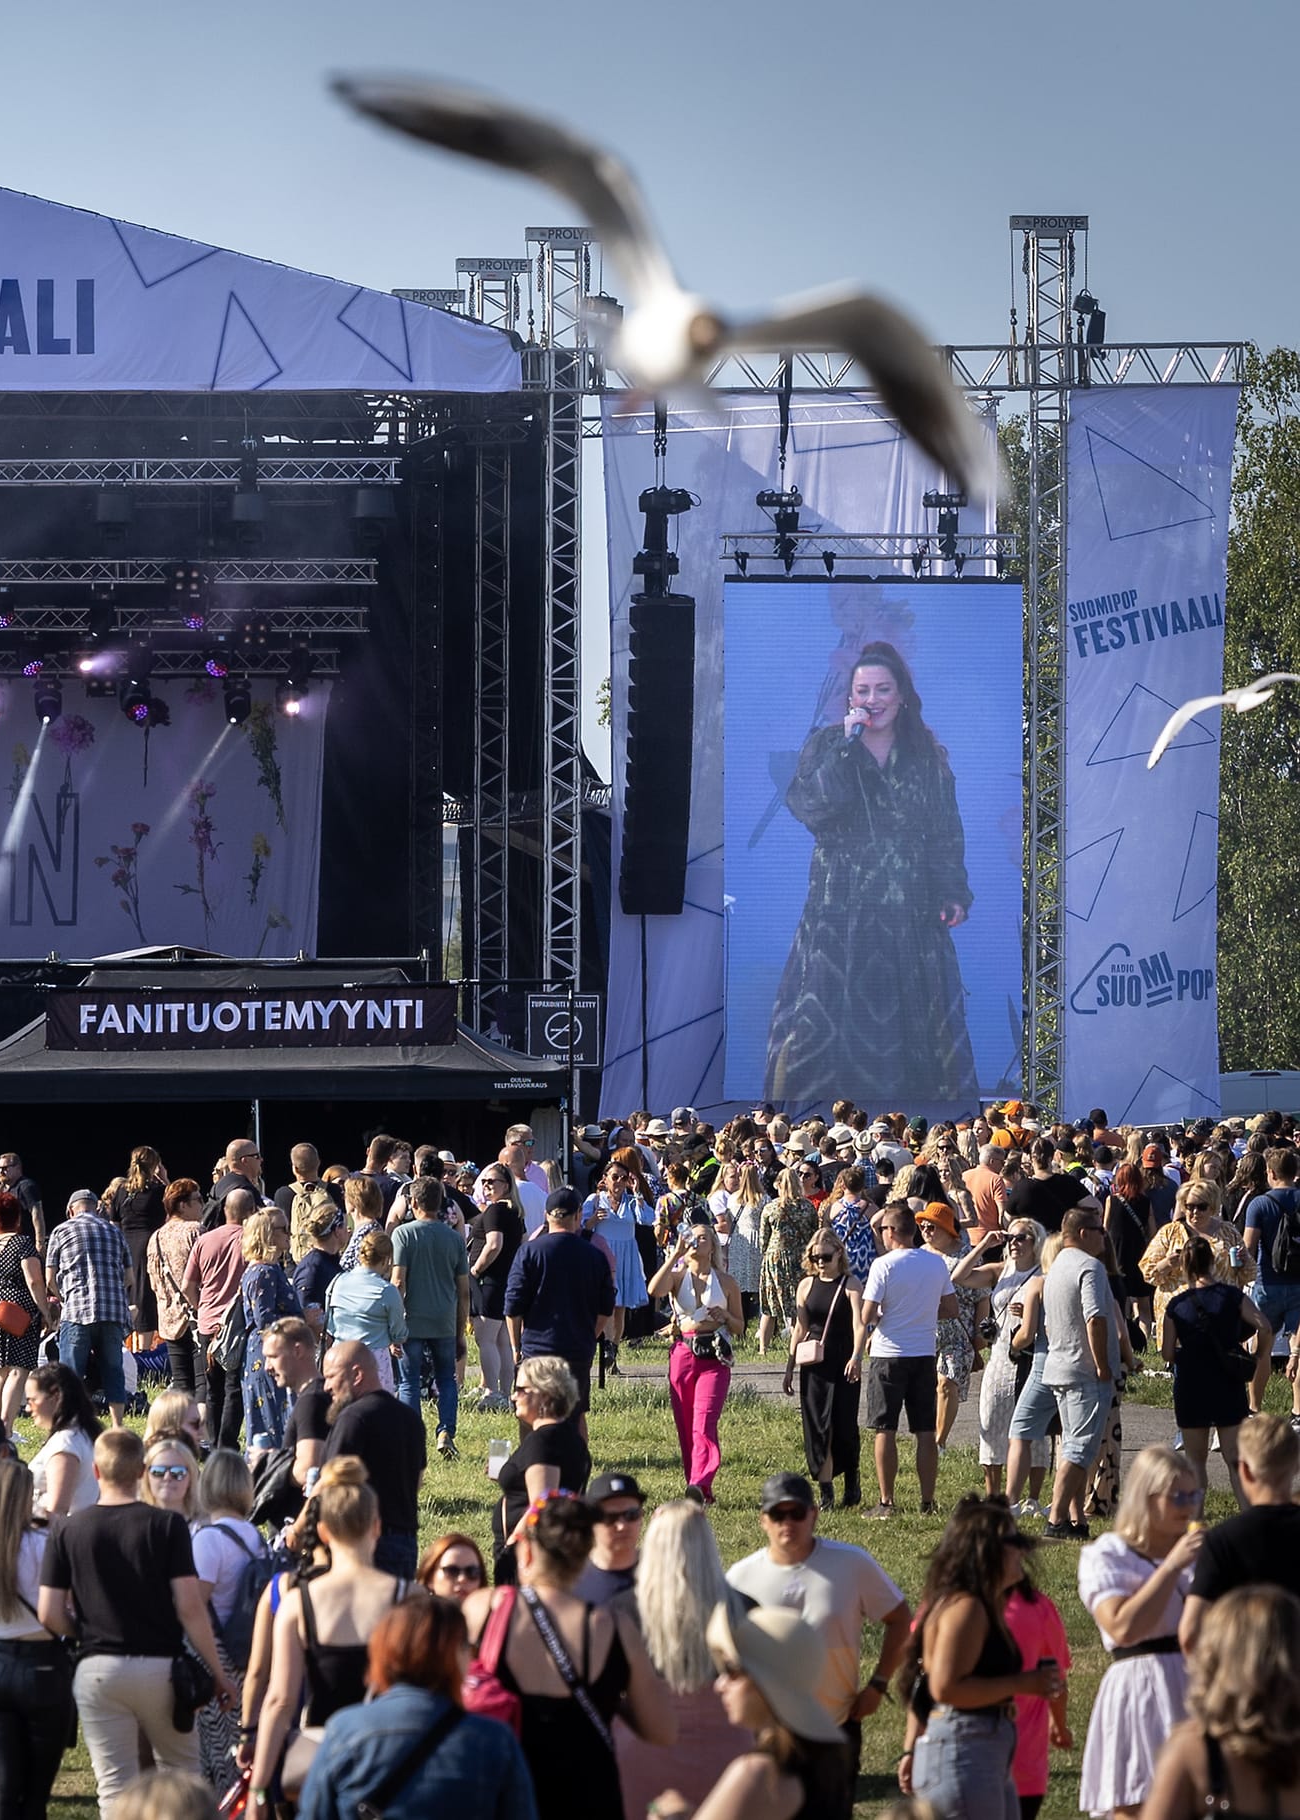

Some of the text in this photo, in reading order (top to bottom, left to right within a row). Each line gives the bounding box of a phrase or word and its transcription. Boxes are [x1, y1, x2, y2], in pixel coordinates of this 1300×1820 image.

[1033, 217, 1081, 229] PROLYTE
[478, 260, 526, 271] PROLYTE
[412, 291, 458, 302] PROLYTE
[1069, 589, 1138, 622] SUOMIPOP
[1073, 593, 1223, 658] FESTIVAALI
[1111, 964, 1134, 973] RADIO
[79, 1000, 423, 1034] FANITUOTEMYYNTI
